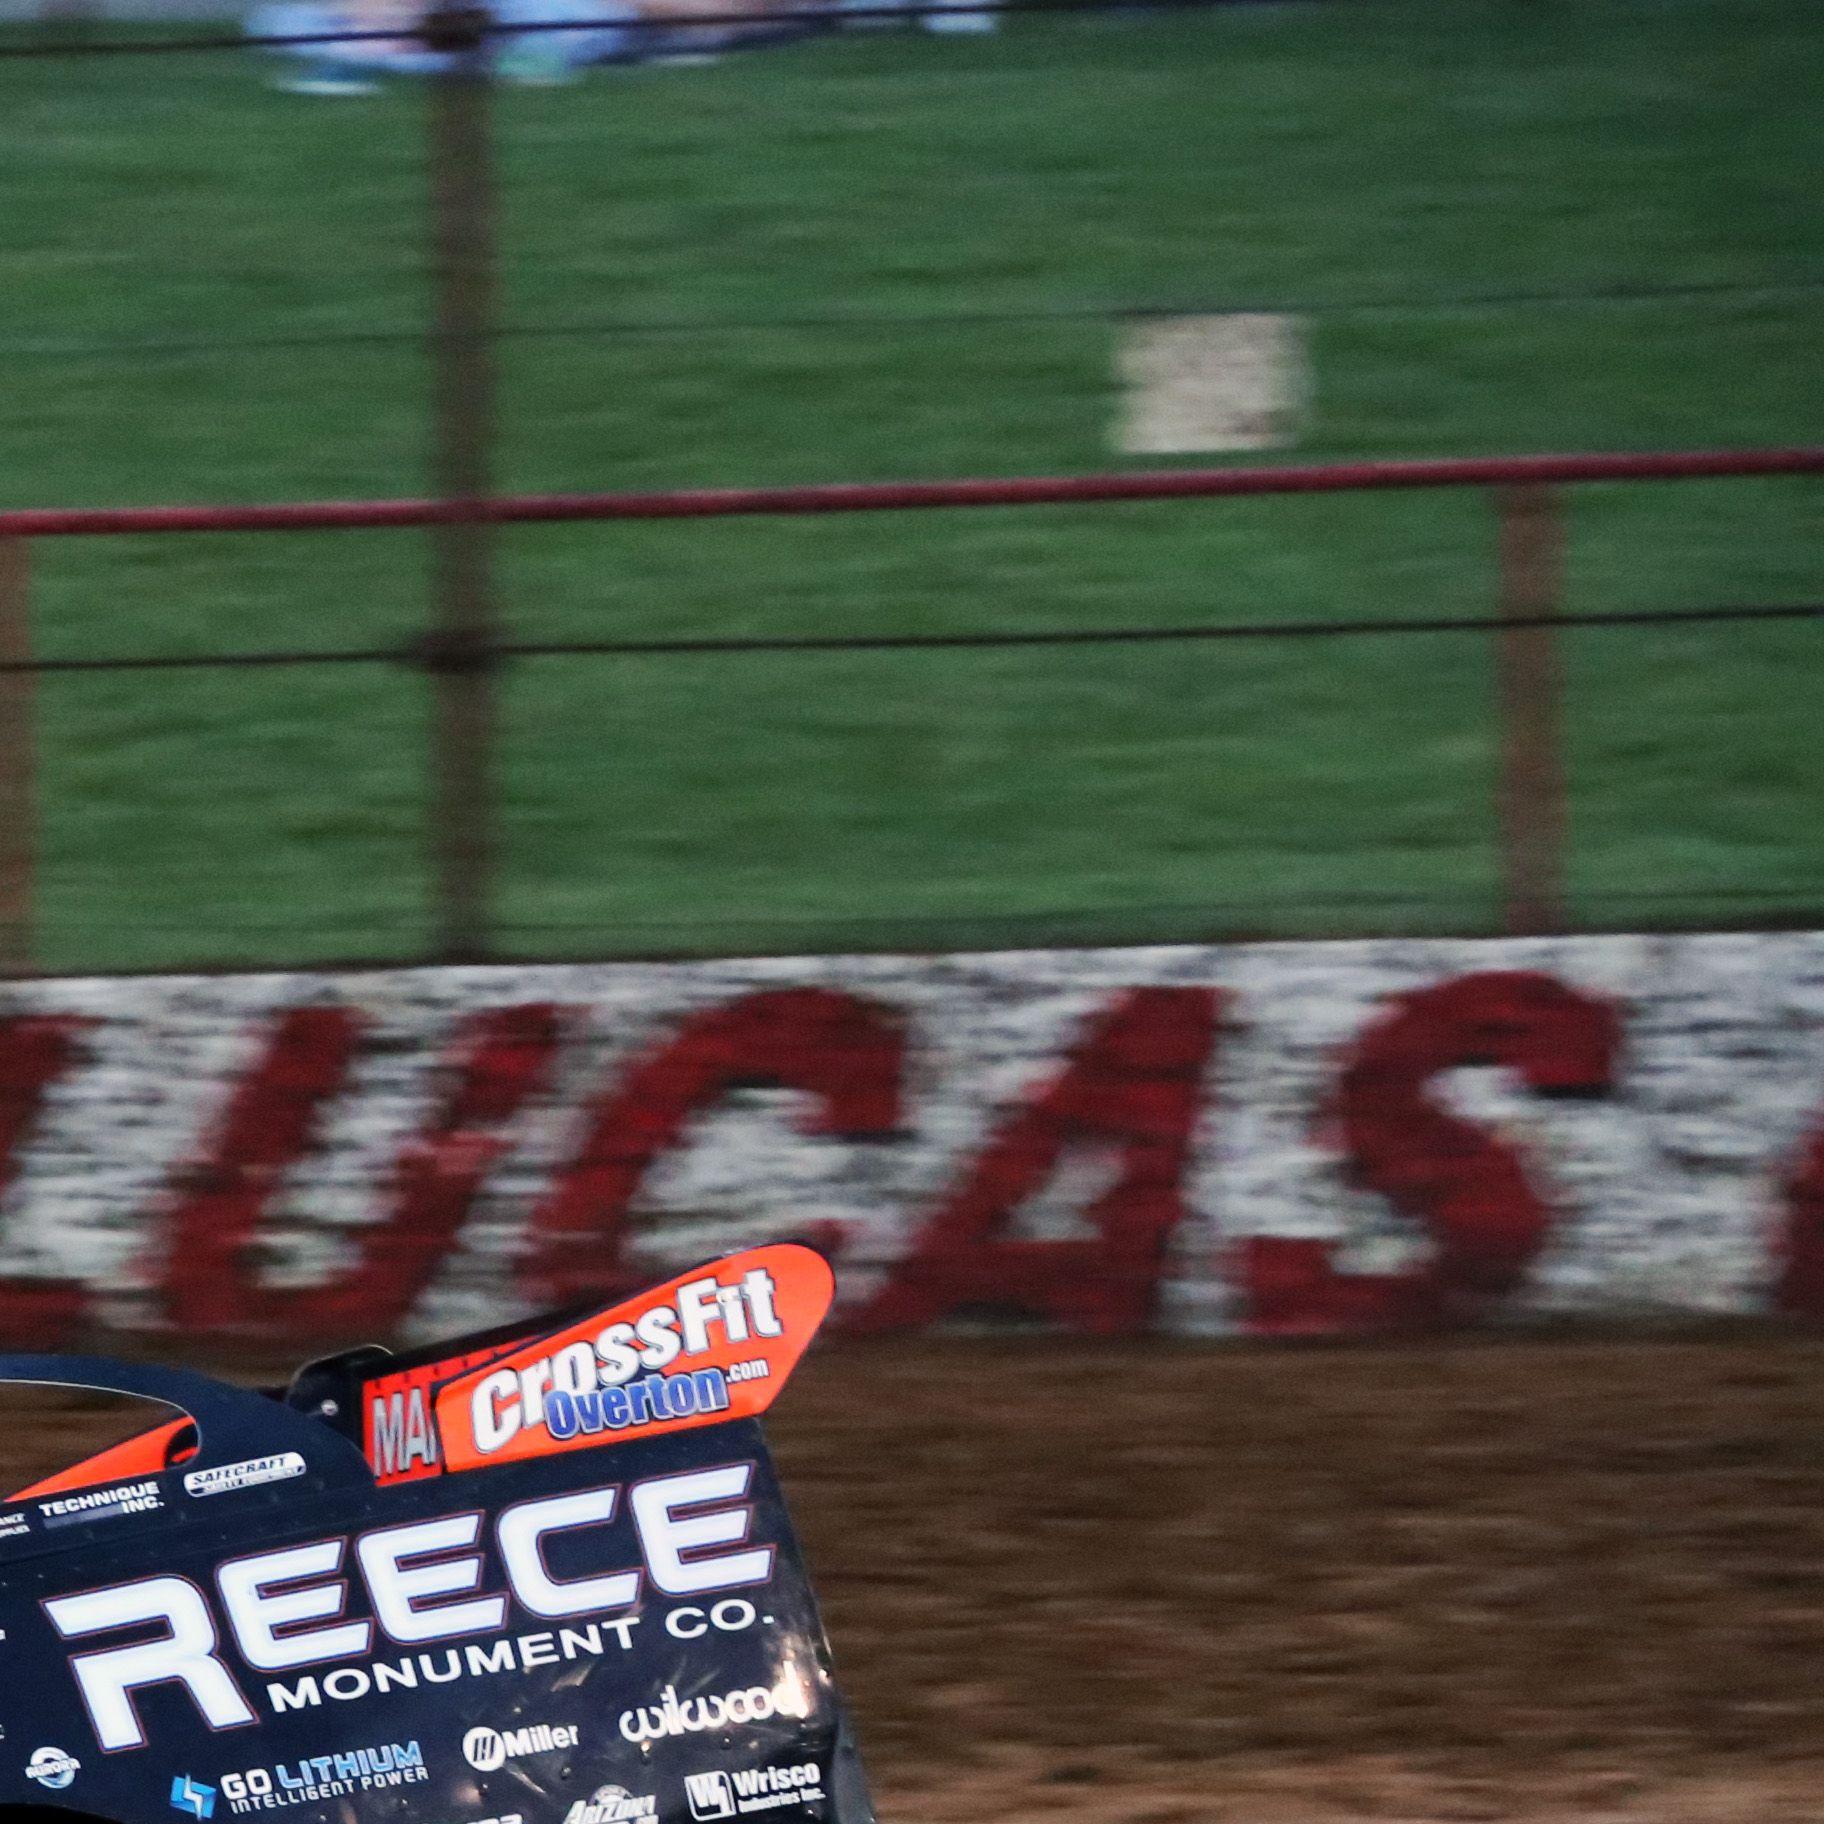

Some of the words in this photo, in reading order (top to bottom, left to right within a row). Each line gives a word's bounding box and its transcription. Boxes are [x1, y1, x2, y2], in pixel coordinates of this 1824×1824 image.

[470, 1268, 783, 1456] CrossFit
[545, 1366, 731, 1441] Overton
[726, 1359, 769, 1384] .com
[192, 1456, 287, 1487] SAFECRAFT
[39, 1481, 160, 1517] TECHNIQUE
[122, 1497, 165, 1515] INC.
[44, 1460, 778, 1754] REECE
[267, 1617, 642, 1713] MONUMENT
[664, 1598, 776, 1640] CO.
[502, 1723, 580, 1757] Miller
[219, 1768, 273, 1801] GO
[275, 1740, 425, 1789] LITHIUM
[230, 1780, 355, 1815] INTELLIGENT
[360, 1766, 430, 1791] POWER
[732, 1762, 821, 1797] Wrisco
